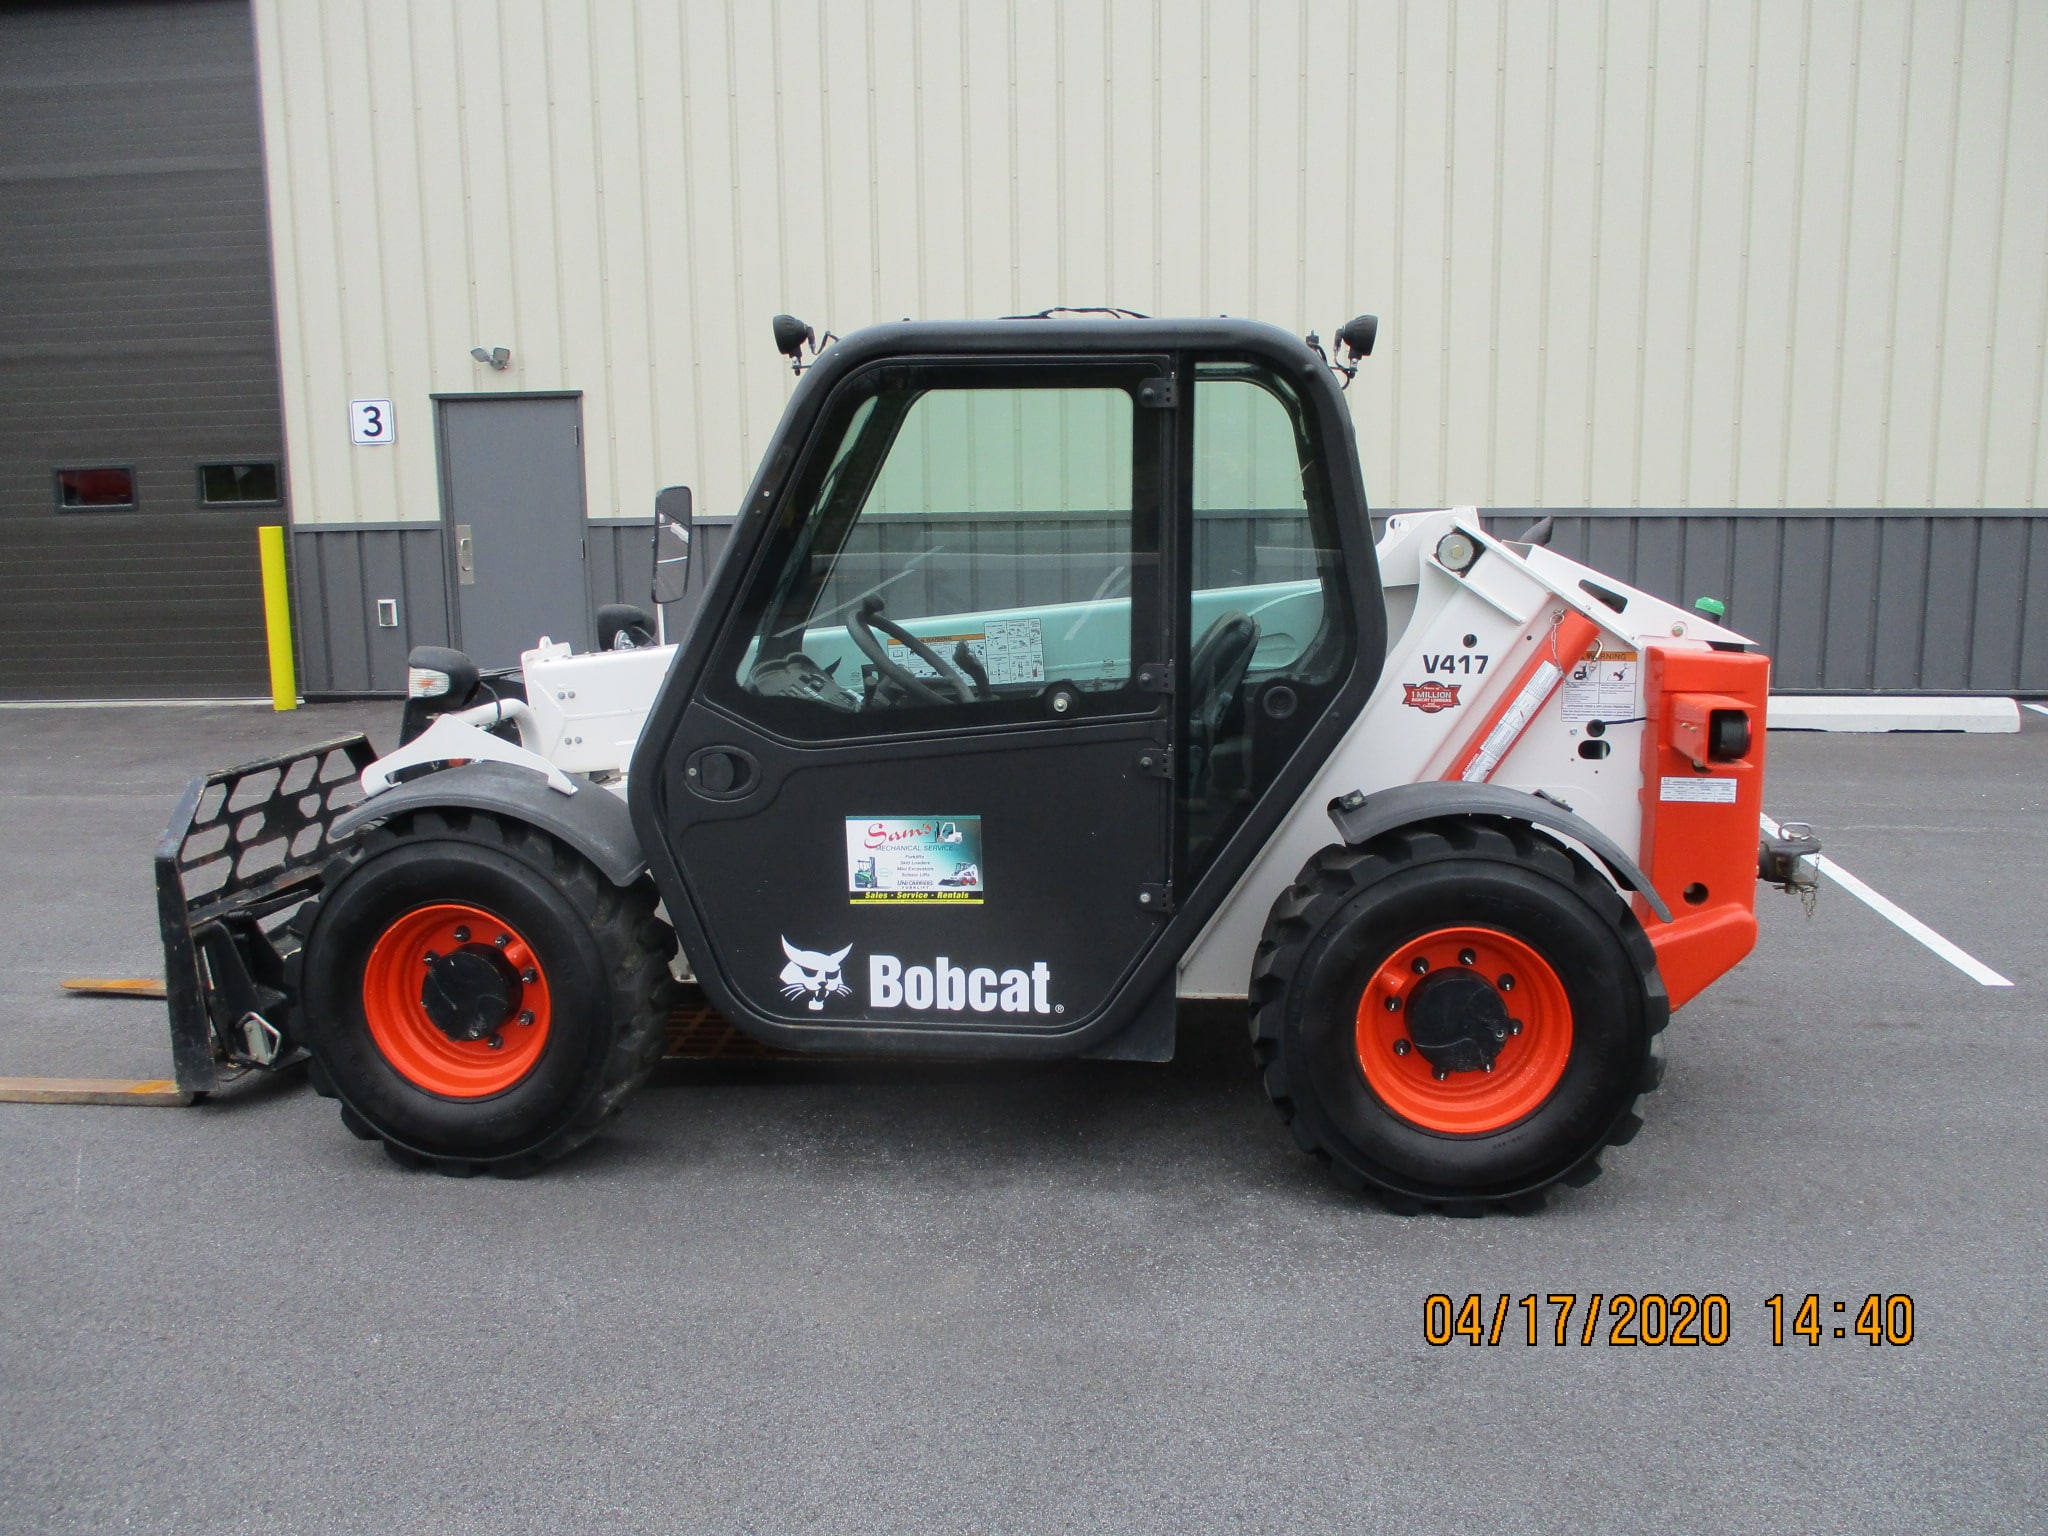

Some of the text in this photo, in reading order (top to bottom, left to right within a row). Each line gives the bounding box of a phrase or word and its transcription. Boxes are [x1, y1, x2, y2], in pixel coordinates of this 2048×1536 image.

[363, 406, 383, 437] 3
[1422, 654, 1489, 675] V417
[1416, 691, 1452, 699] MILLION
[865, 891, 888, 899] Sales
[896, 891, 928, 899] Service
[869, 954, 1051, 1014] Bobcat
